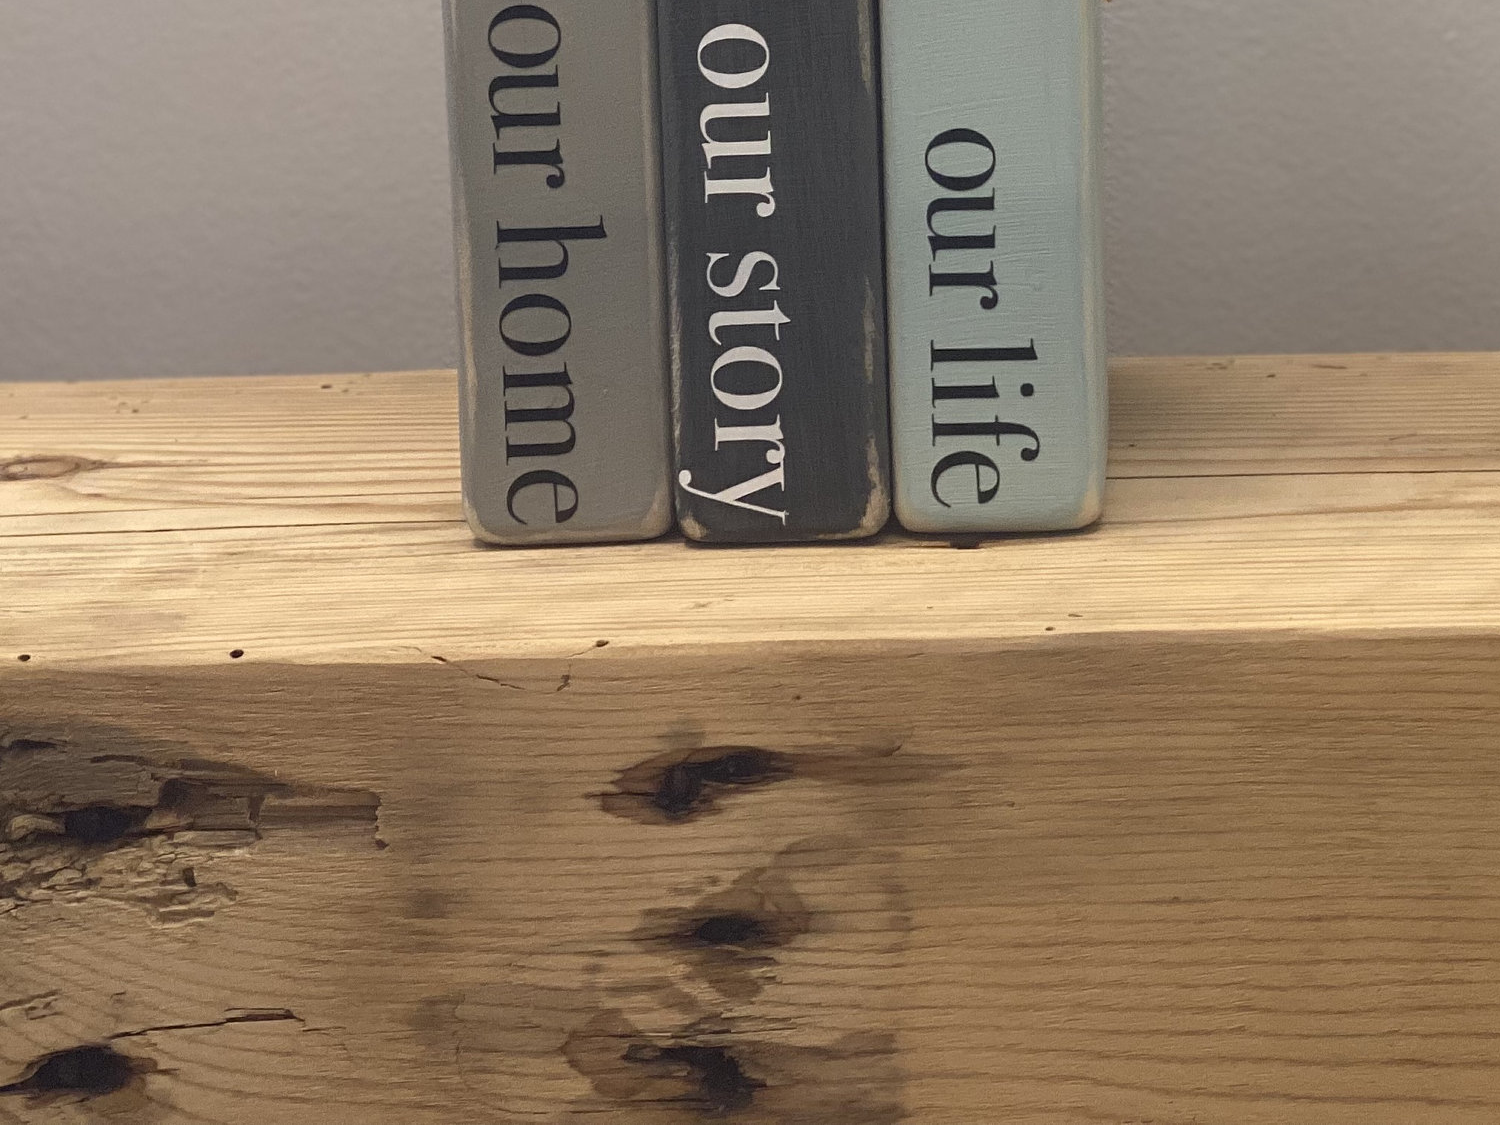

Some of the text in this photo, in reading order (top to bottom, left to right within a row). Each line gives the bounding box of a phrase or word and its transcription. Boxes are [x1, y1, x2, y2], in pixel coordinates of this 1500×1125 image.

[487, 4, 607, 525] our home
[678, 23, 791, 526] our story
[924, 127, 1040, 509] our life
